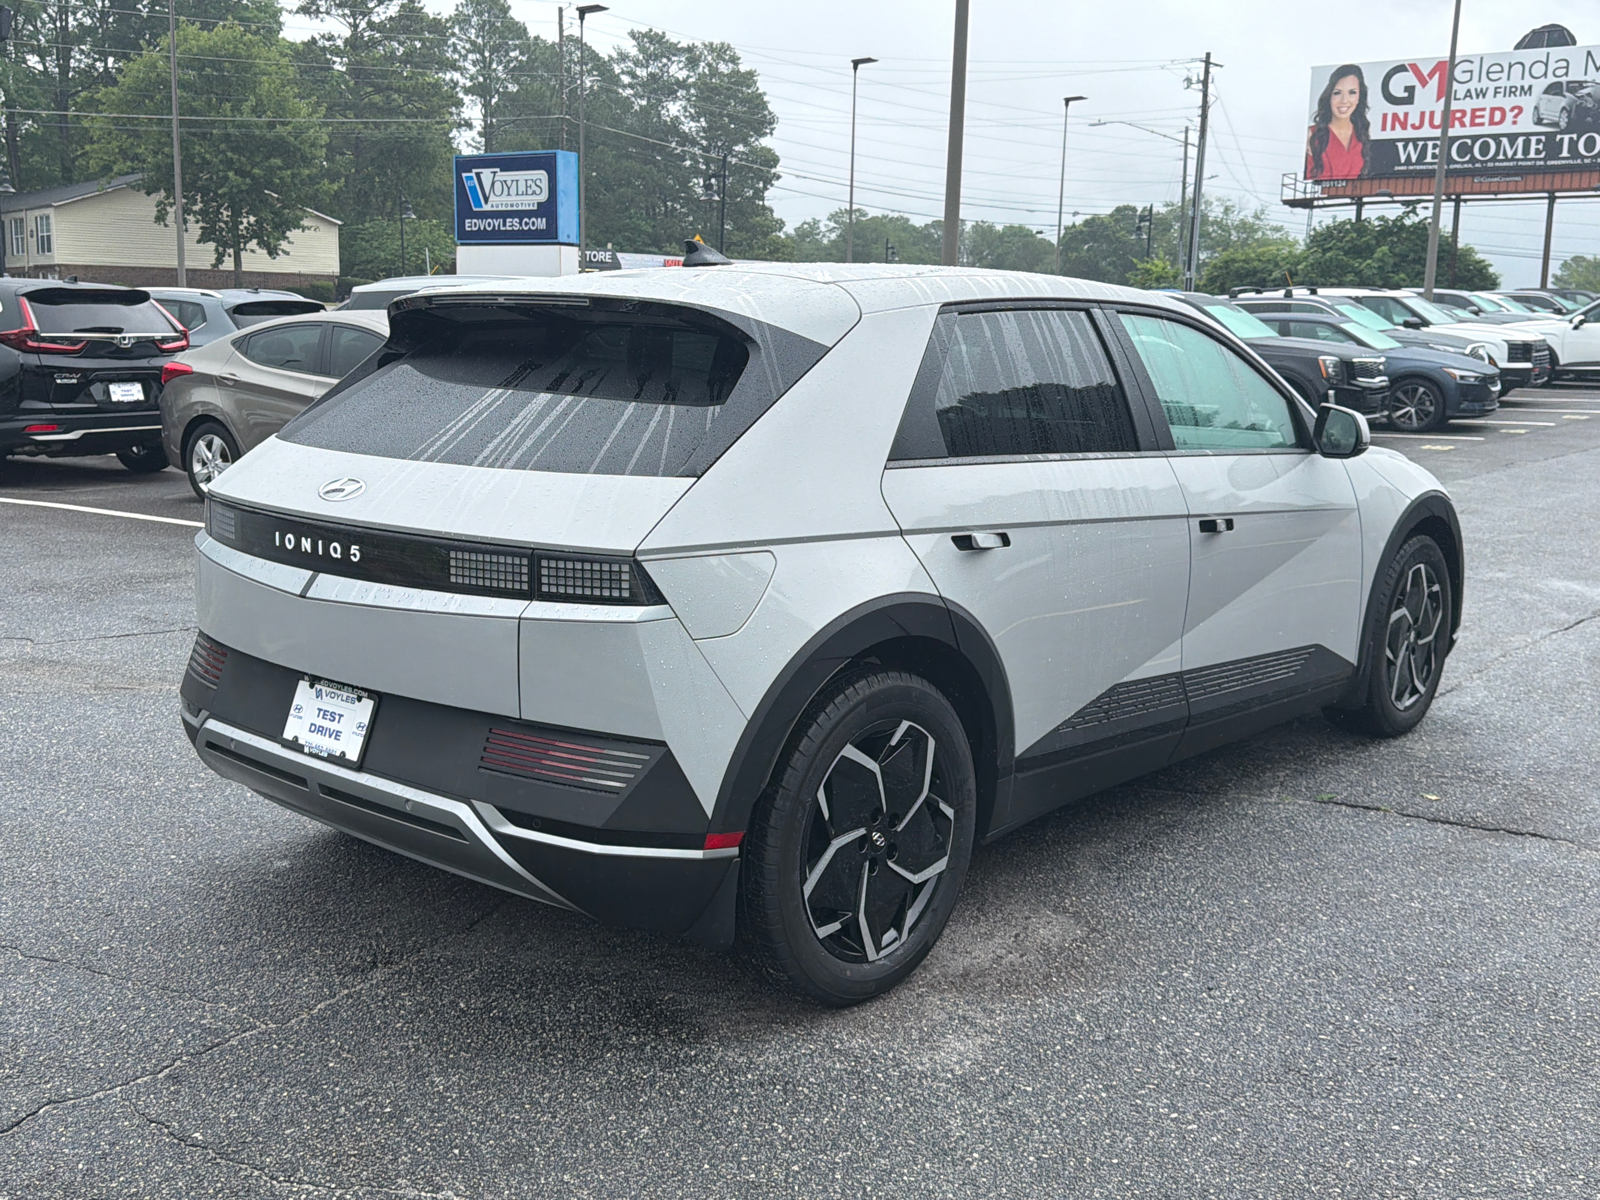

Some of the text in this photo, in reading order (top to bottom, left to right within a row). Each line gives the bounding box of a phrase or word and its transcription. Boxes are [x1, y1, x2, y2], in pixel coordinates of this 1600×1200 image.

[1453, 52, 1570, 84] Glenda
[1381, 60, 1449, 106] GM
[1453, 84, 1533, 101] LAW FIRM
[1381, 105, 1524, 132] INJURED?
[1395, 132, 1600, 164] WECOME TO
[474, 171, 543, 206] VOYLES
[465, 217, 547, 231] EDVOYLES.COM
[275, 531, 361, 562] IONIQ 5
[325, 689, 356, 705] VOYLES
[316, 707, 344, 724] TEST
[308, 722, 342, 741] DRIVE
